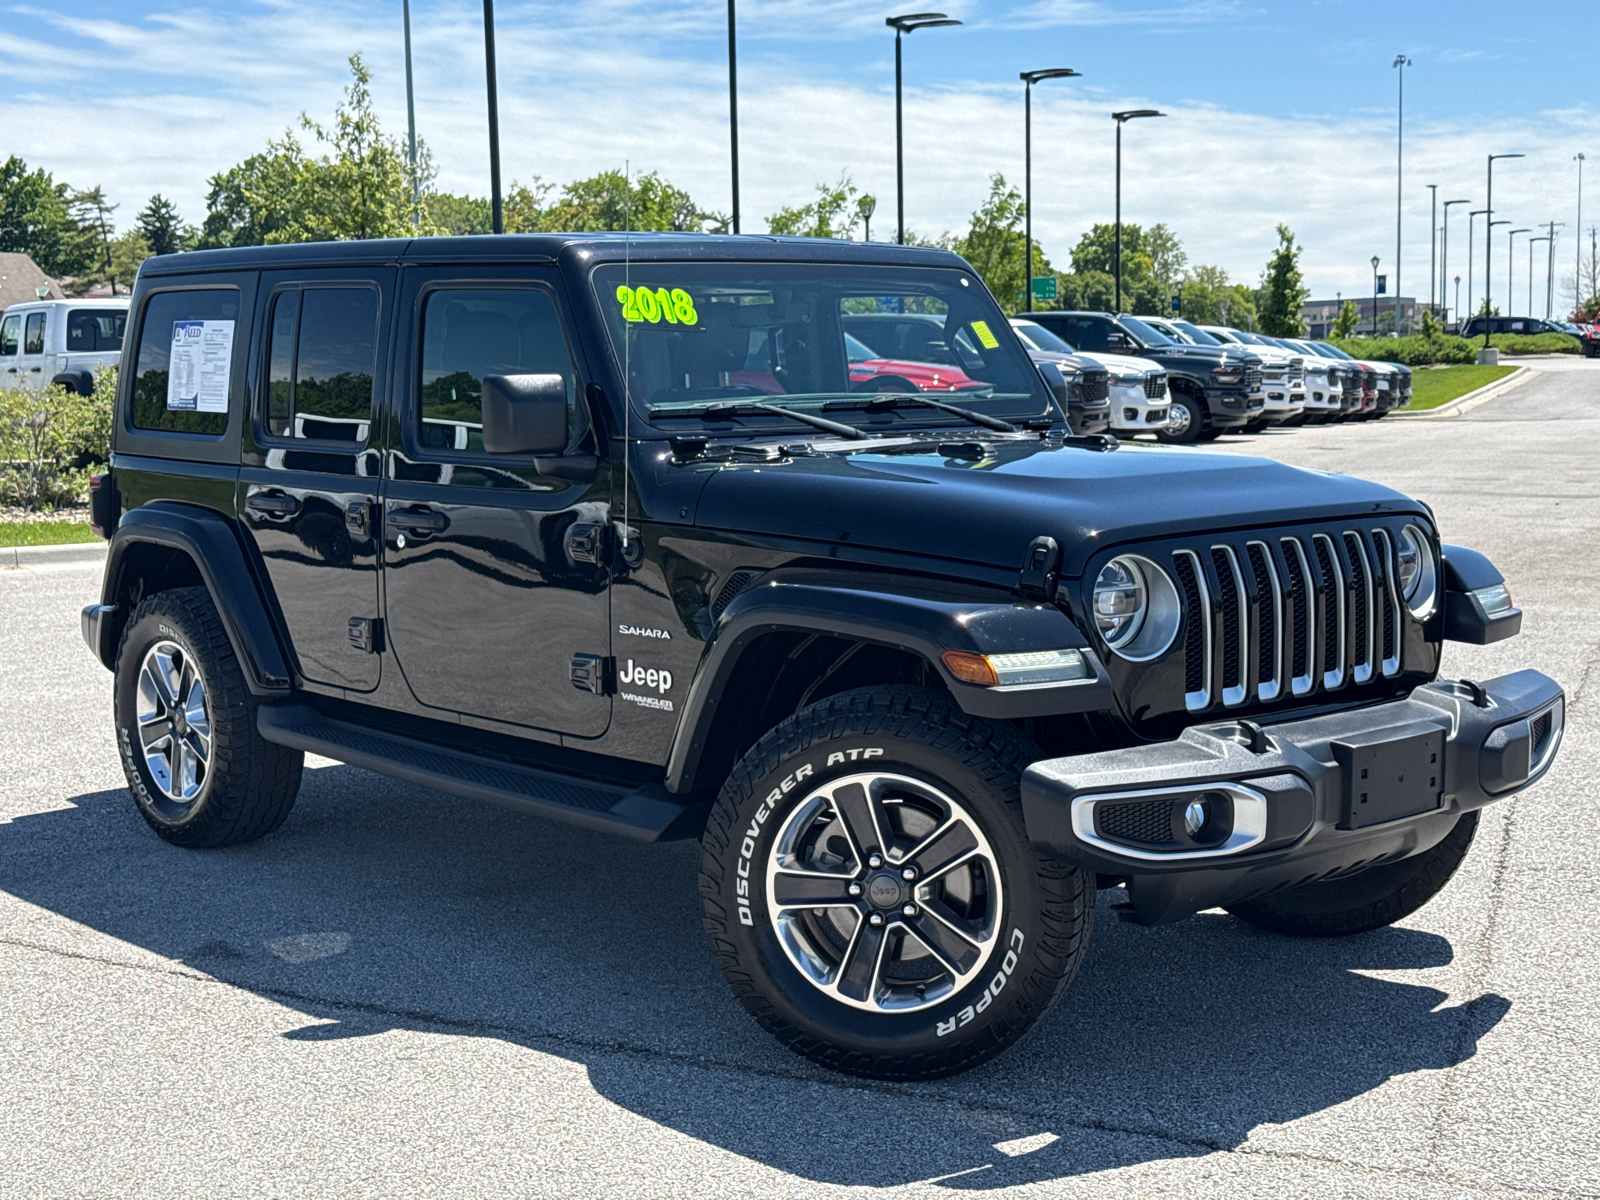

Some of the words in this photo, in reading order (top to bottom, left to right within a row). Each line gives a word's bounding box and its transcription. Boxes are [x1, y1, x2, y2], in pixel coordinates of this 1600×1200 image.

[616, 285, 698, 325] 2018
[619, 625, 671, 640] SAHARA
[620, 659, 672, 694] Jeep
[621, 692, 673, 707] WRANGLER
[121, 727, 154, 806] COOPER
[735, 763, 814, 926] DISCOVERER
[826, 747, 885, 767] ATP
[872, 886, 897, 897] Jeep
[936, 928, 1025, 1039] COOPER
